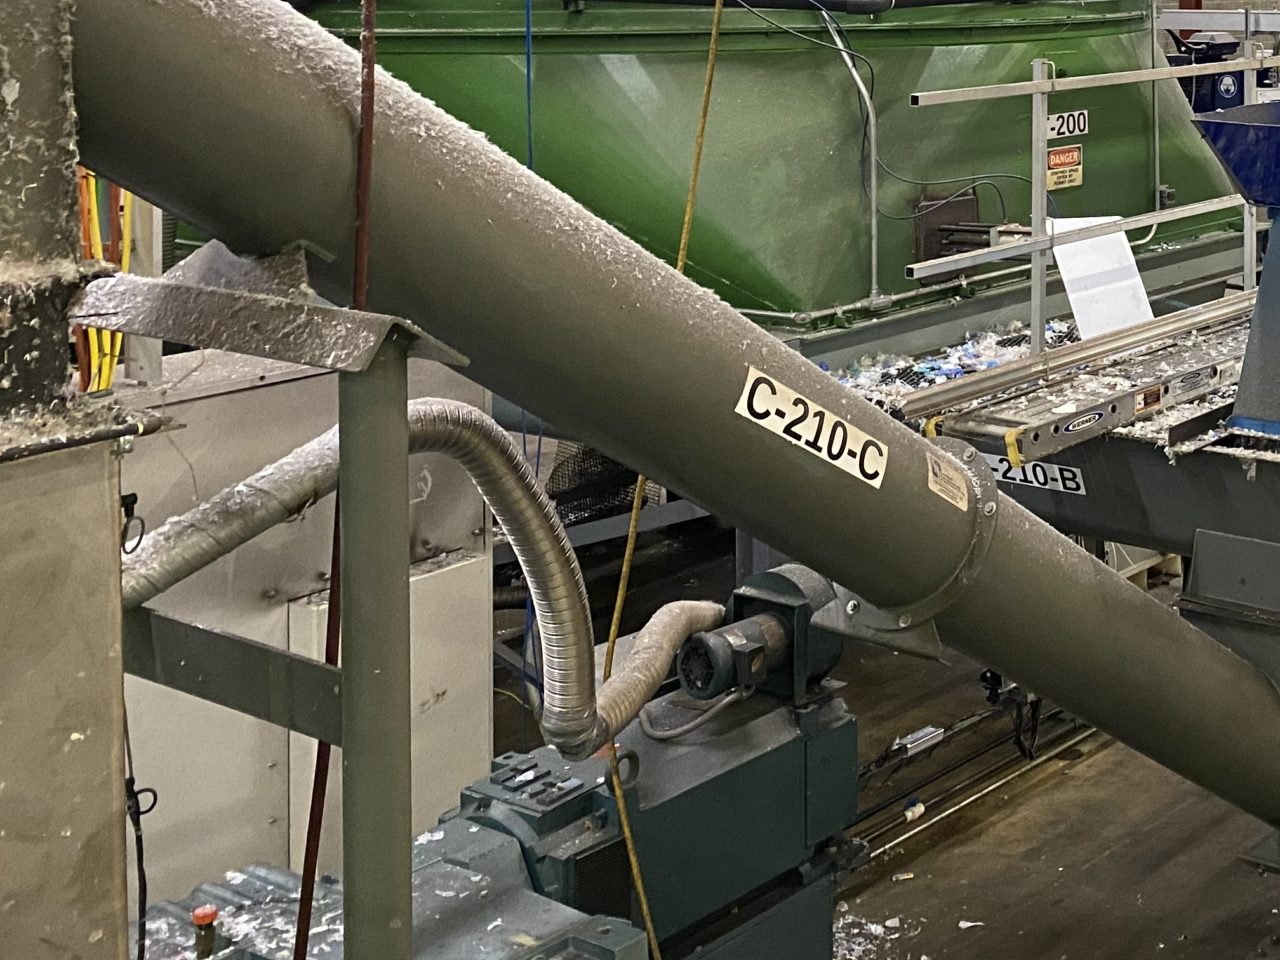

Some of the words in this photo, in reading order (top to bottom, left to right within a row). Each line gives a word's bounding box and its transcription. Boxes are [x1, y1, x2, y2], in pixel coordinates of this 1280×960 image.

[1047, 112, 1086, 136] -200
[1050, 152, 1079, 165] DANGER
[746, 376, 884, 481] C-210-C
[1071, 415, 1097, 430] WERNER
[990, 457, 1081, 492] -210-B
